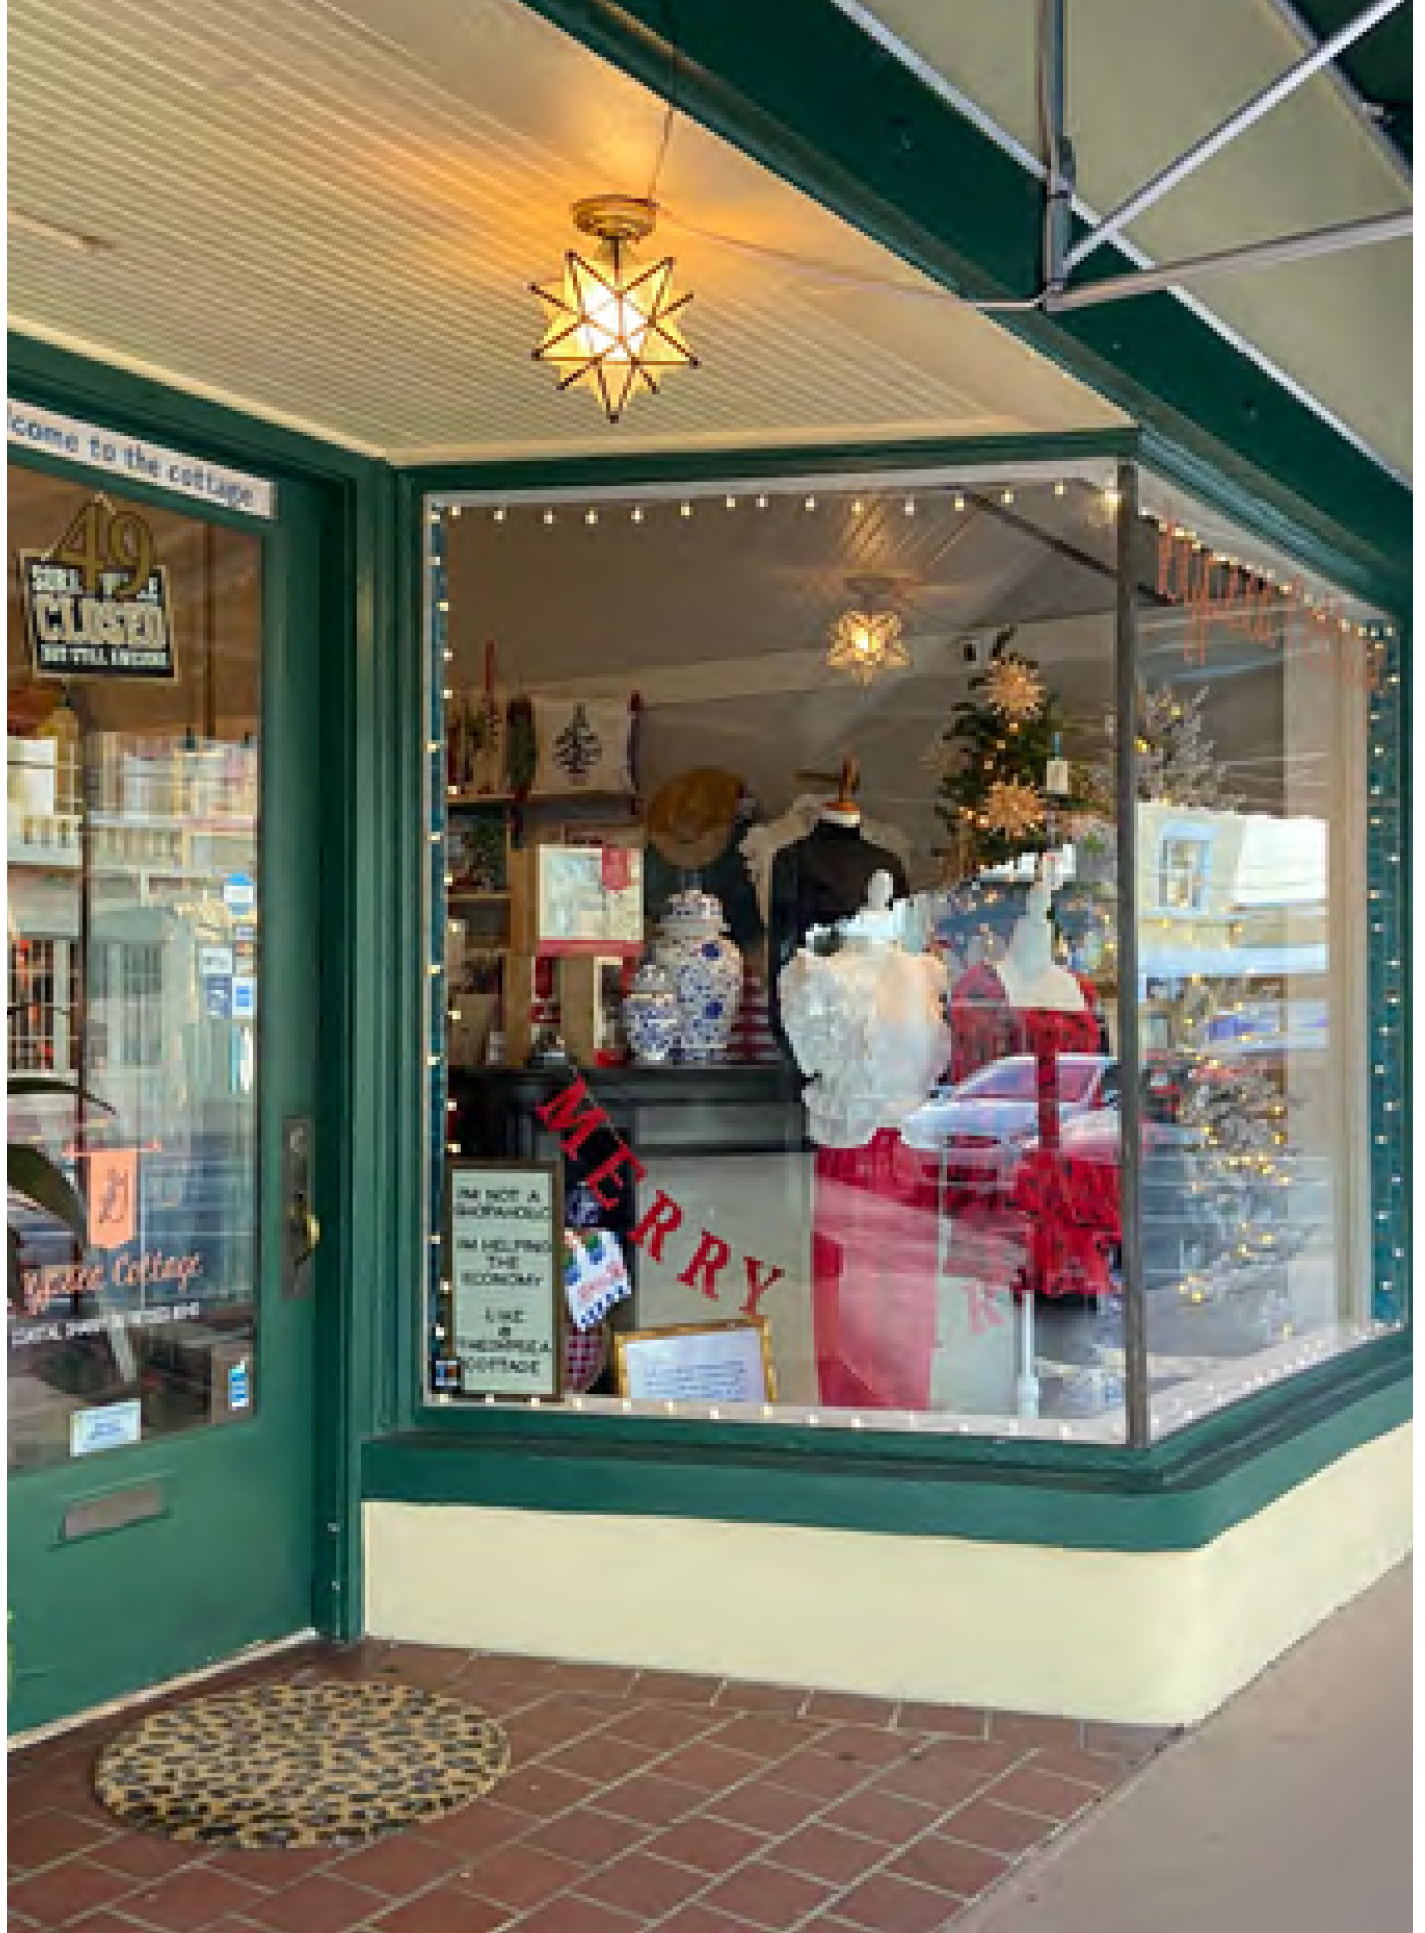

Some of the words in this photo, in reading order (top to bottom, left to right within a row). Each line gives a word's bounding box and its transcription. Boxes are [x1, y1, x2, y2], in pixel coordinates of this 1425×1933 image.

[89, 438, 117, 462] to
[124, 443, 160, 478] the
[167, 465, 254, 509] cottage
[52, 499, 154, 601] 49
[34, 597, 166, 648] CLOSED
[484, 1186, 520, 1200] NOT
[527, 1187, 541, 1202] A
[535, 1075, 786, 1316] MERRY
[480, 1236, 552, 1252] HELPING
[486, 1254, 521, 1269] THE
[111, 1249, 202, 1291] Cottage
[461, 1270, 544, 1286] ECONOMY
